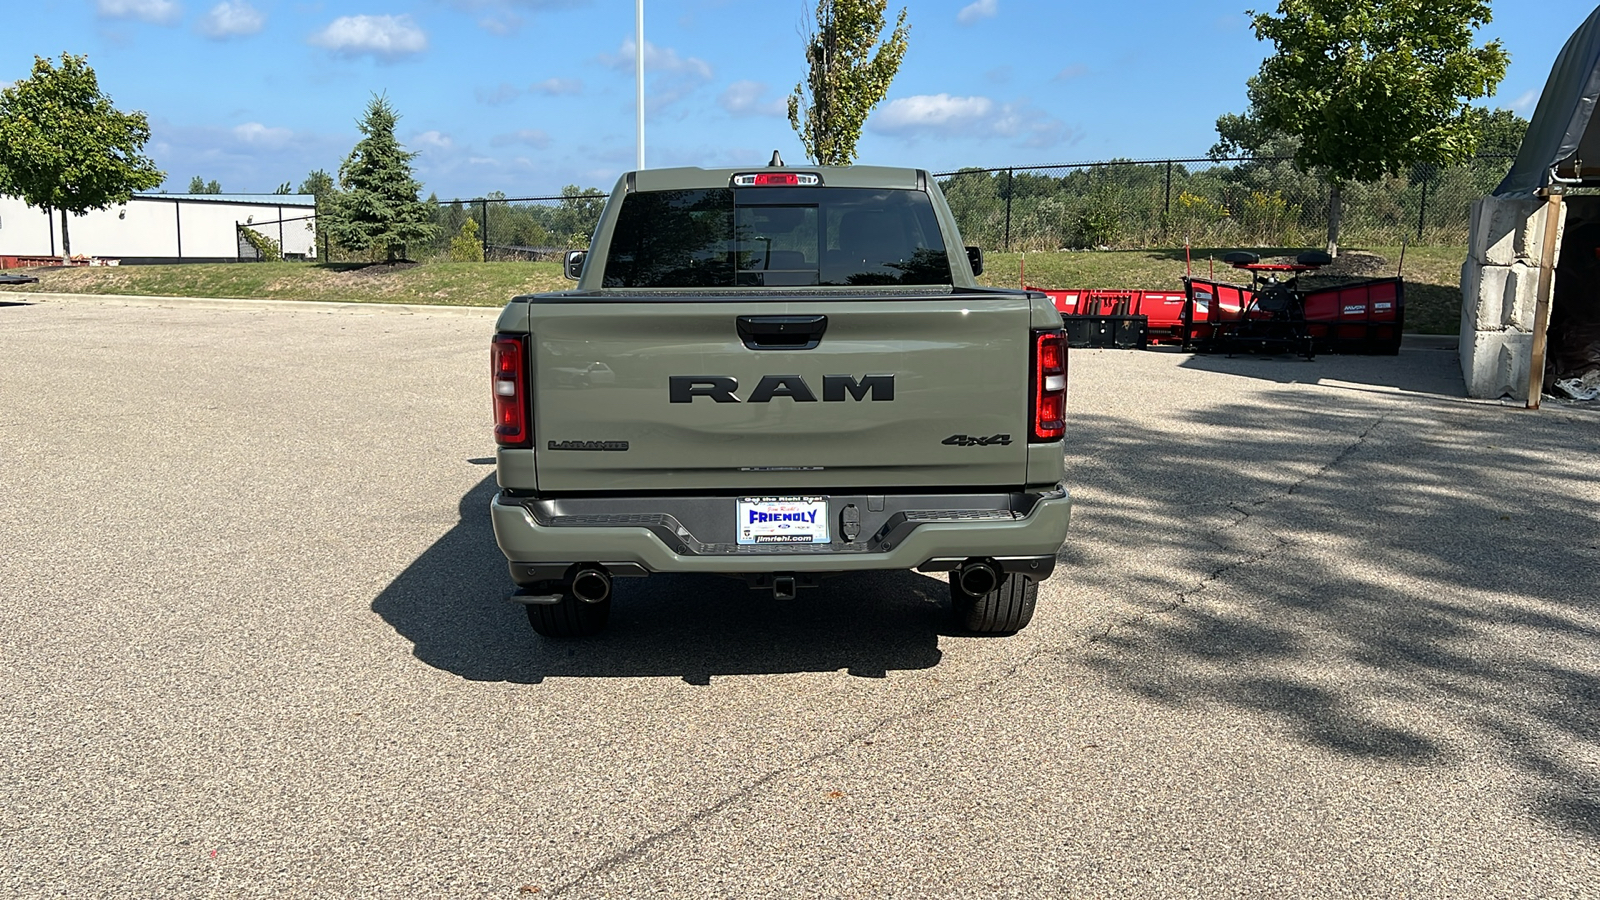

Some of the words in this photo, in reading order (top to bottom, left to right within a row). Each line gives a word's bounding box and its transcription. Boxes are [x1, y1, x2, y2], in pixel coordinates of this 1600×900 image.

[669, 373, 895, 403] RAM
[548, 440, 629, 451] LARAMIE
[941, 434, 1013, 446] 4x4
[749, 509, 817, 525] FRIENDLY
[756, 535, 812, 543] jimriehl.com
